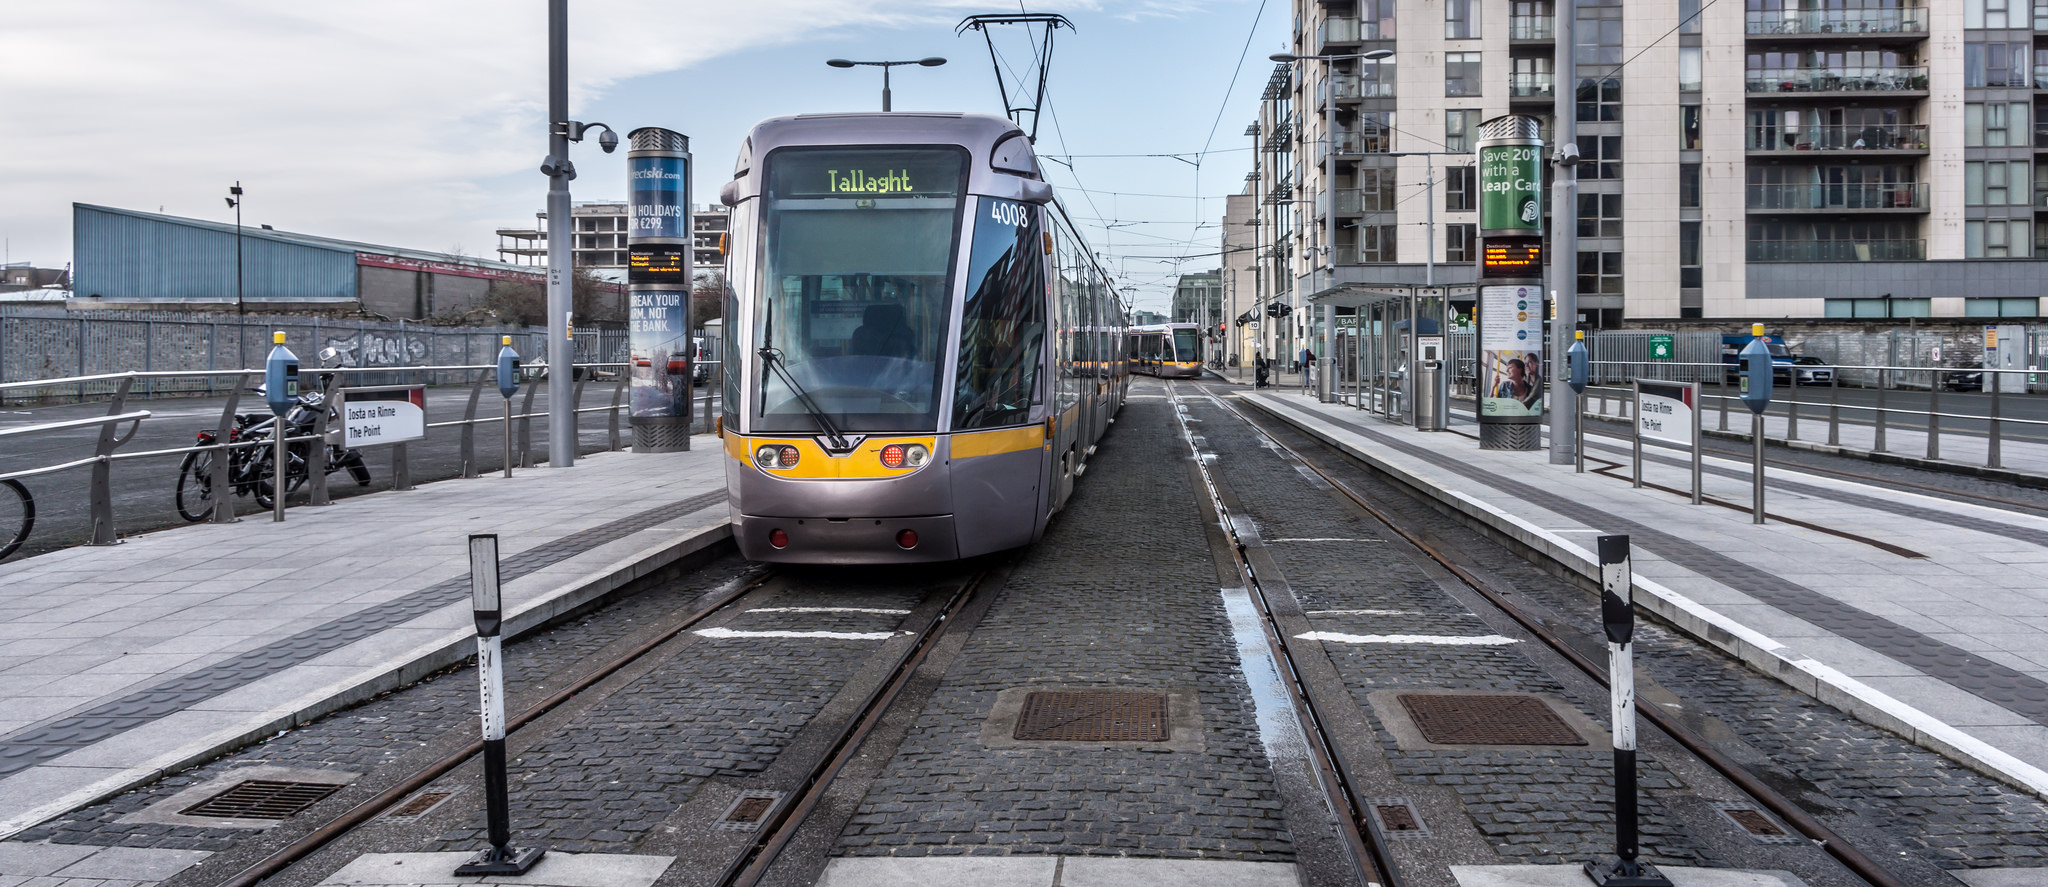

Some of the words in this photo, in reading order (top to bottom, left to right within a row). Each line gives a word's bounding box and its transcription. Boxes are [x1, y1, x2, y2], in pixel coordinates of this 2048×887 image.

[1483, 150, 1508, 163] Save
[1512, 148, 1540, 162] 20%
[1482, 163, 1507, 177] with
[1512, 166, 1519, 176] a
[828, 169, 913, 193] Tallaght
[1482, 180, 1511, 195] Leap
[638, 204, 681, 218] HOLIDAYS
[991, 201, 1028, 228] 4008
[641, 217, 663, 230] €299.
[630, 294, 653, 307] BREAK
[655, 294, 680, 307] YOUR
[648, 307, 667, 320] NOT
[642, 320, 670, 332] BANK.
[348, 408, 366, 420] Iosta
[368, 409, 376, 419] na
[378, 405, 396, 418] Rinne
[349, 426, 362, 439] The
[363, 424, 381, 437] Point
[1641, 417, 1650, 430] The
[1650, 419, 1662, 432] Point
